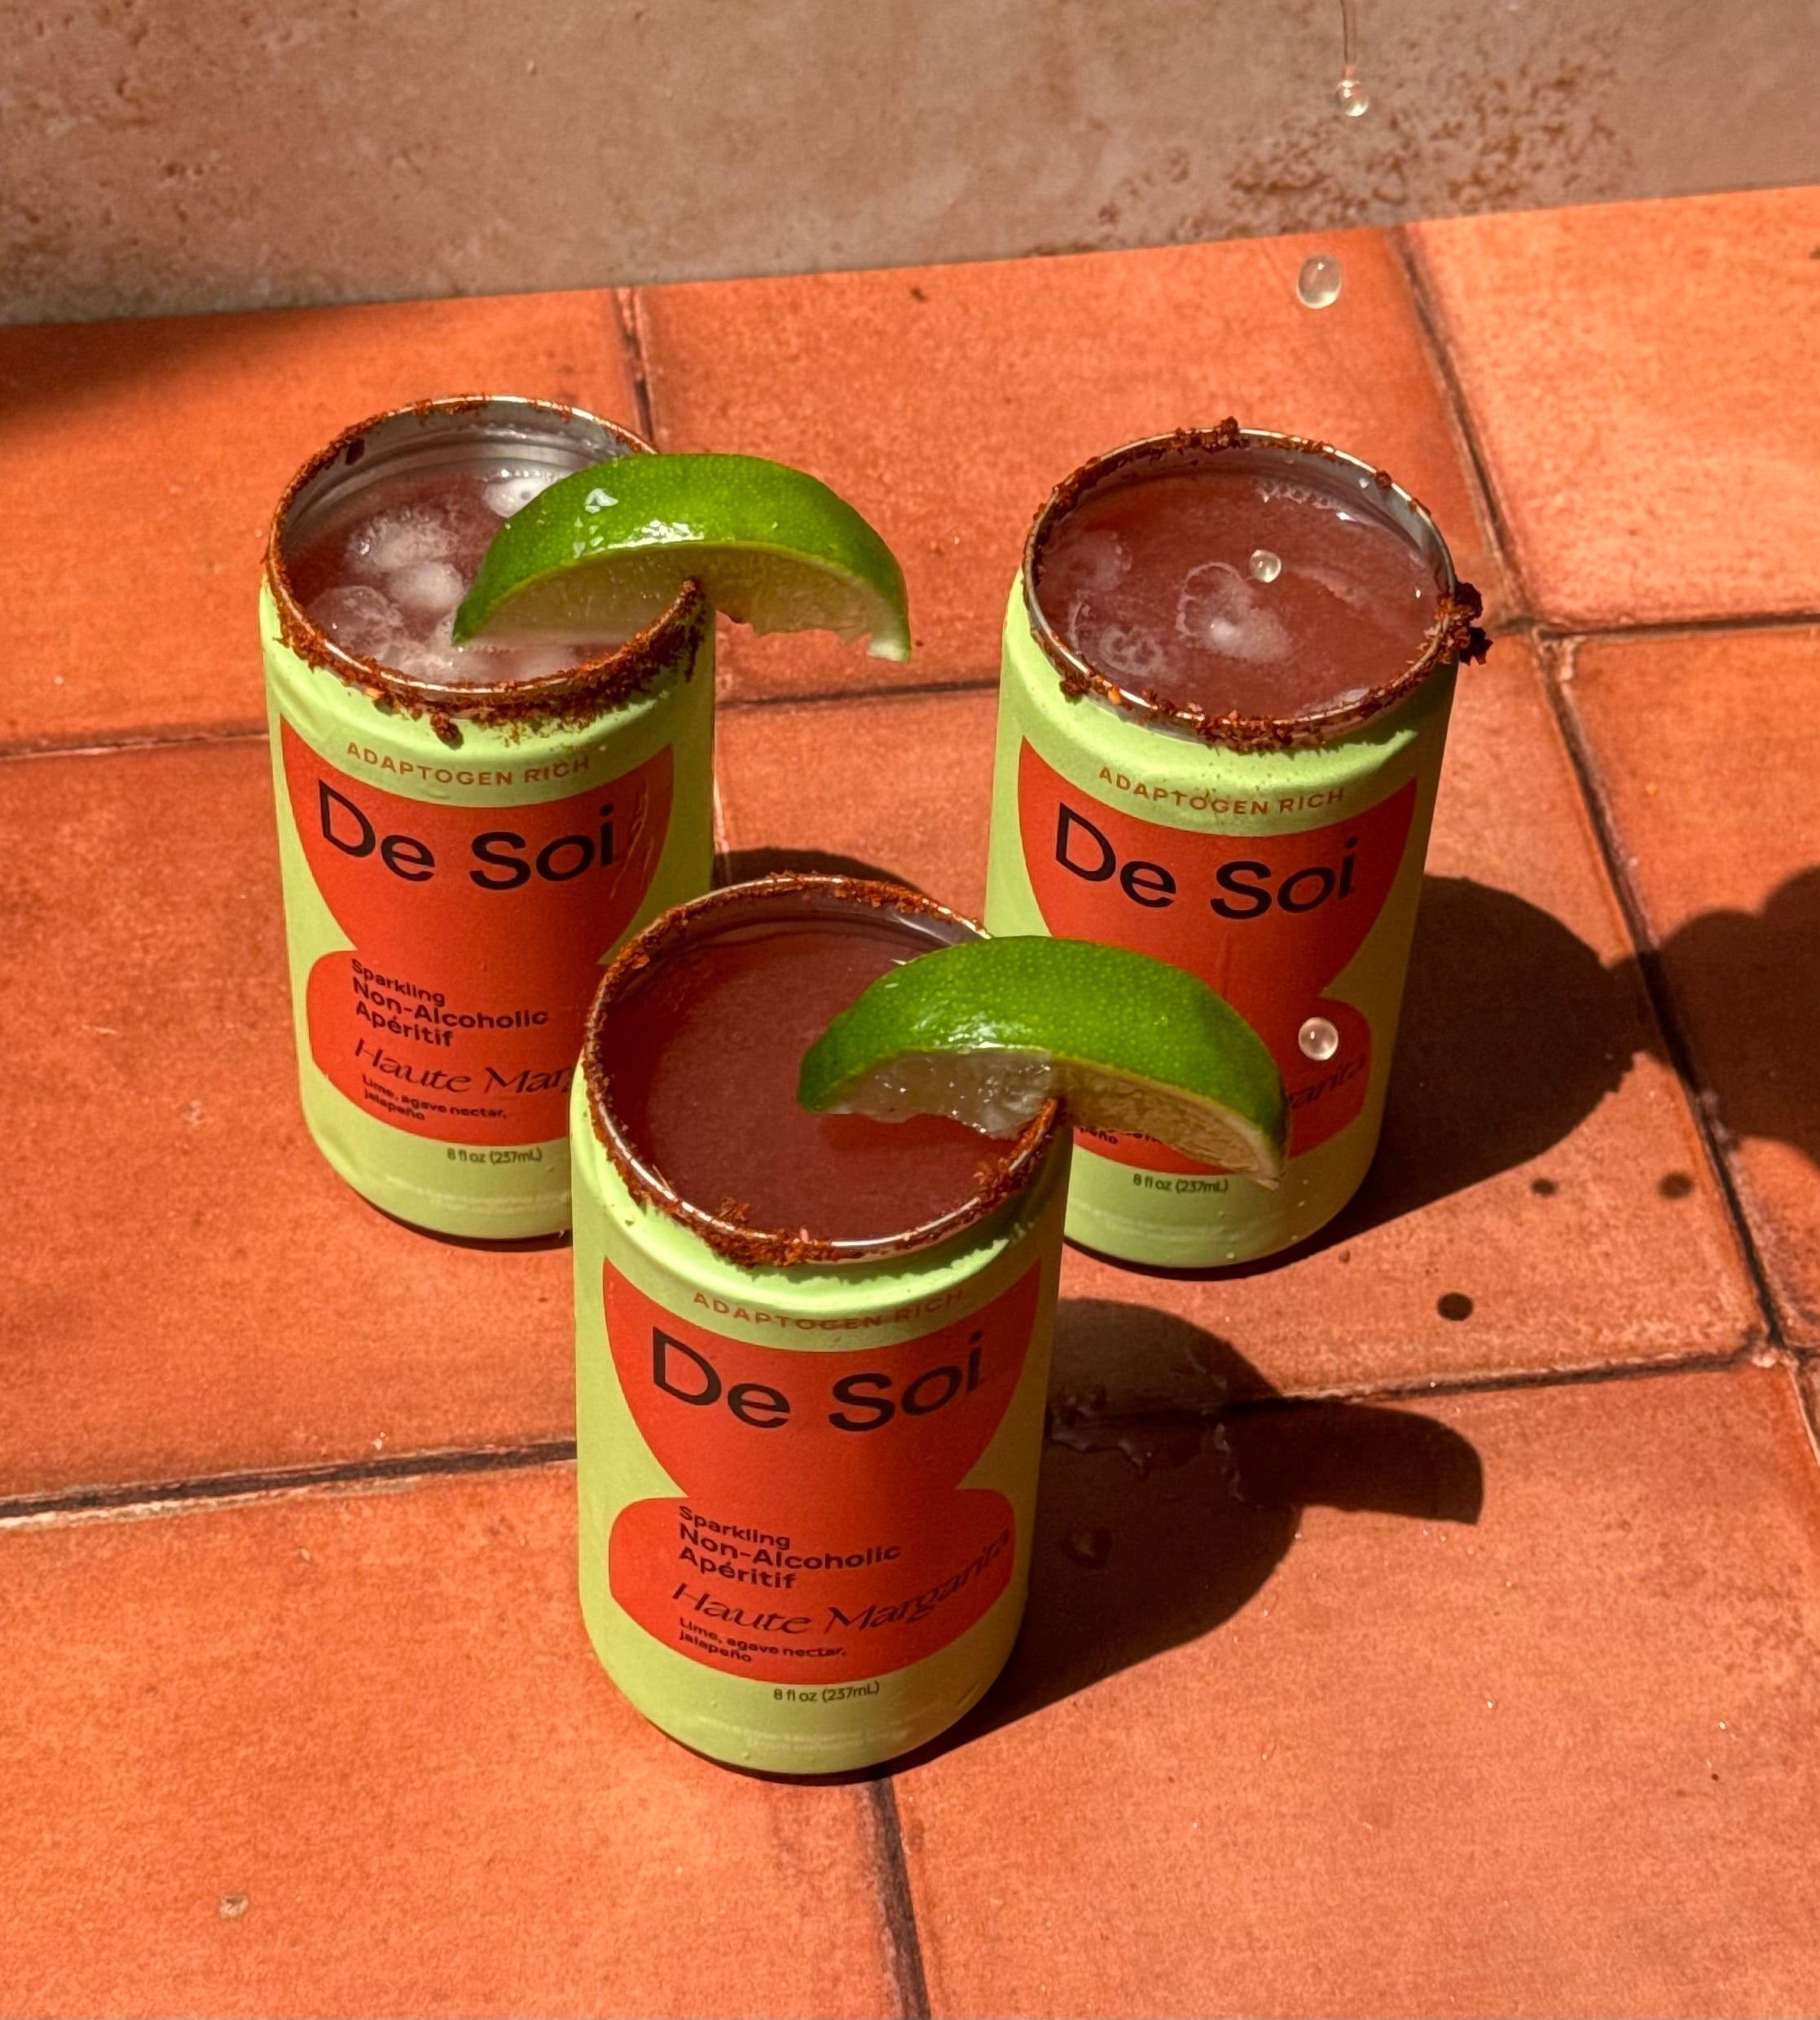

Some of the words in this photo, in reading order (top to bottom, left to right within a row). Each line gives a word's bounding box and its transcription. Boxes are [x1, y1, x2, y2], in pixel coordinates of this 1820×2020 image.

[346, 742, 513, 786] ADAPTOGEN
[524, 756, 591, 784] RICH
[1098, 766, 1268, 815] ADAPTOGEN
[1278, 787, 1345, 813] RICH
[318, 779, 436, 882] De
[469, 803, 615, 891] Soi
[1056, 802, 1176, 908] De
[1210, 836, 1358, 920] Soi
[351, 957, 446, 1007] Sparkling
[352, 976, 549, 1030] Non-Alcoholic
[355, 1000, 454, 1048] Apéritif
[354, 1038, 473, 1094] Haute
[401, 1094, 448, 1113] agave
[447, 1147, 455, 1161] 8
[458, 1147, 468, 1163] fl
[469, 1151, 486, 1164] oz
[1133, 1173, 1141, 1186] 8
[1145, 1174, 1153, 1189] fl
[1154, 1179, 1172, 1192] oz
[692, 1292, 882, 1331] ADAPTOGEN
[895, 1289, 963, 1323] RICH
[653, 1327, 790, 1428] De
[828, 1331, 983, 1432] Soi
[679, 1505, 791, 1551] Sparkling
[679, 1522, 901, 1571] Non-Alcoholic
[672, 1582, 812, 1635] Haute
[824, 1527, 1011, 1635] Margarita
[679, 1547, 796, 1589] Apéritif
[679, 1617, 723, 1644] Lime,
[727, 1637, 780, 1655] agave
[679, 1630, 752, 1663] jalapeño
[774, 1688, 783, 1701] 8
[787, 1688, 796, 1701] fl
[799, 1692, 818, 1702] oz
